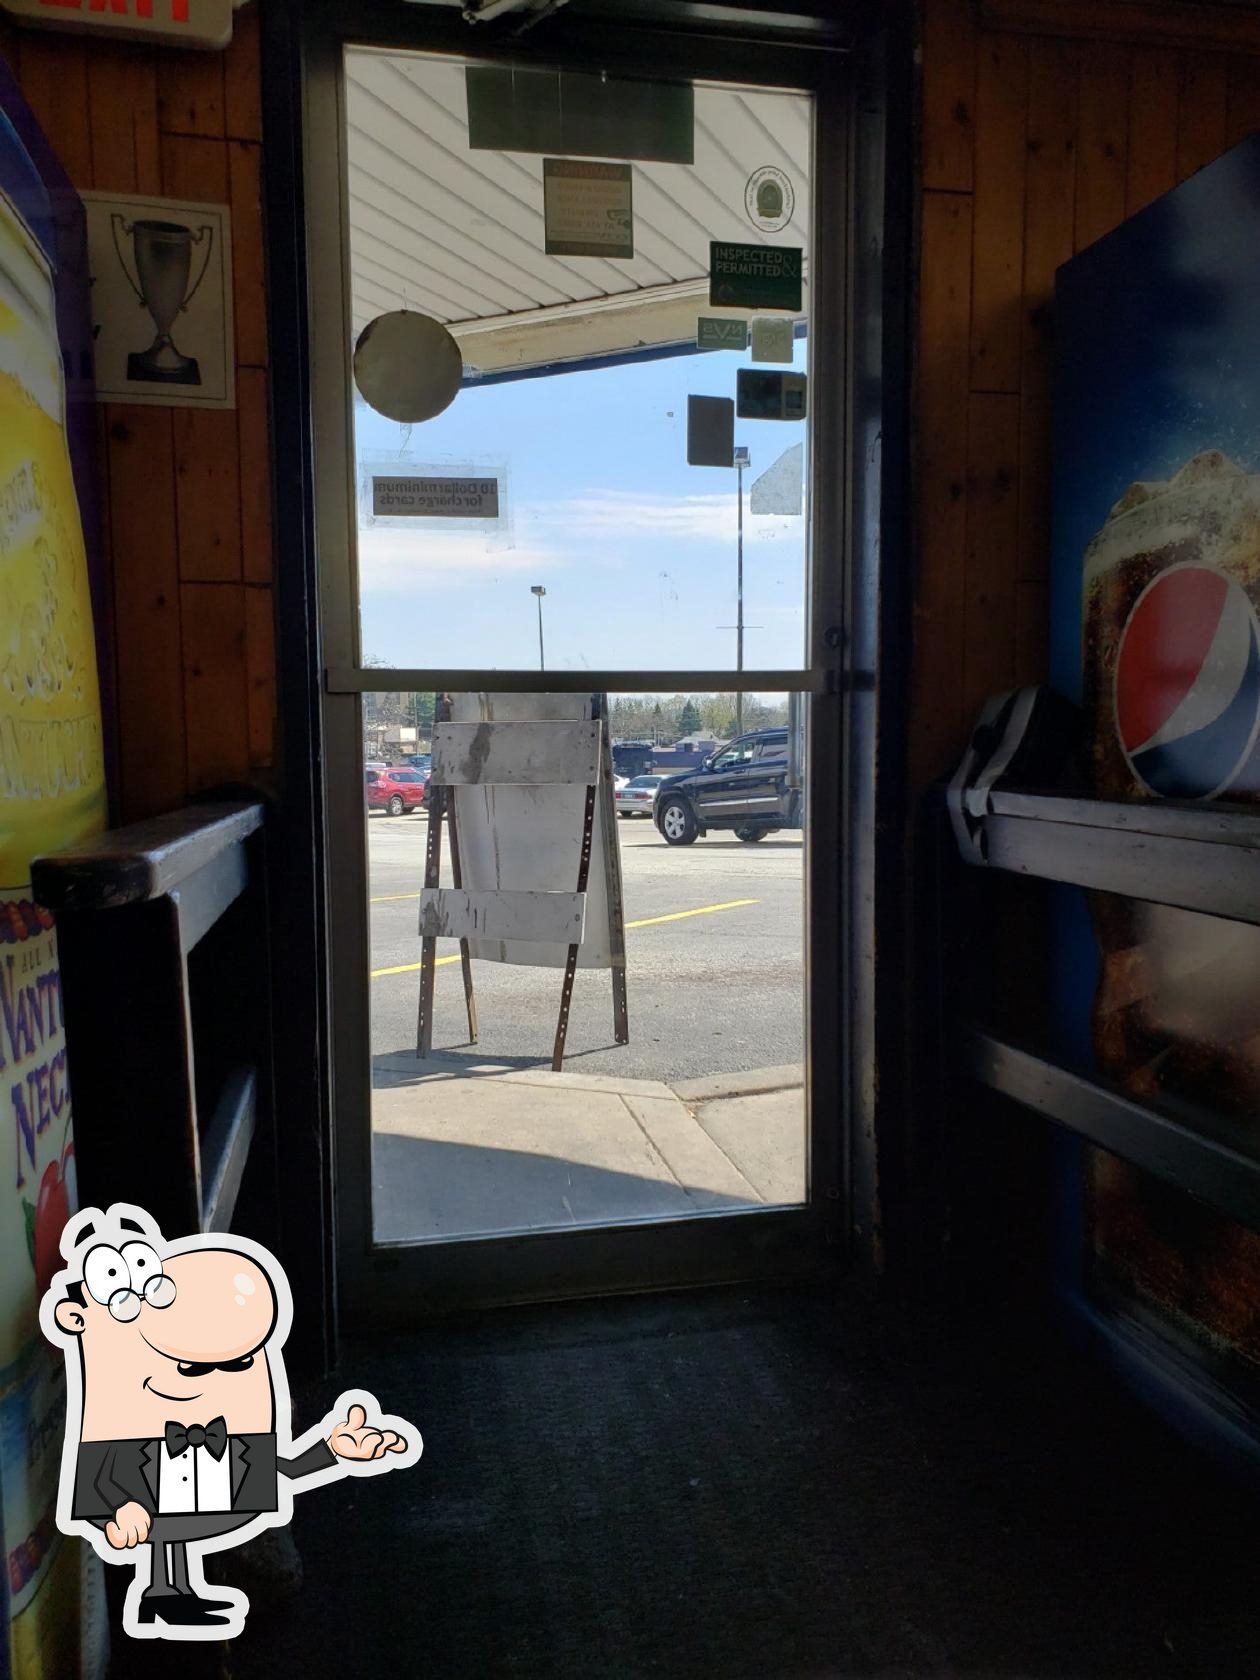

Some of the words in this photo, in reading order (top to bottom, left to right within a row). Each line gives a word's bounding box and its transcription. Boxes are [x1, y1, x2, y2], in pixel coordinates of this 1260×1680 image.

[715, 247, 783, 264] INSPECTED
[715, 261, 781, 277] PERMITTED
[11, 1046, 71, 1188] NEC
